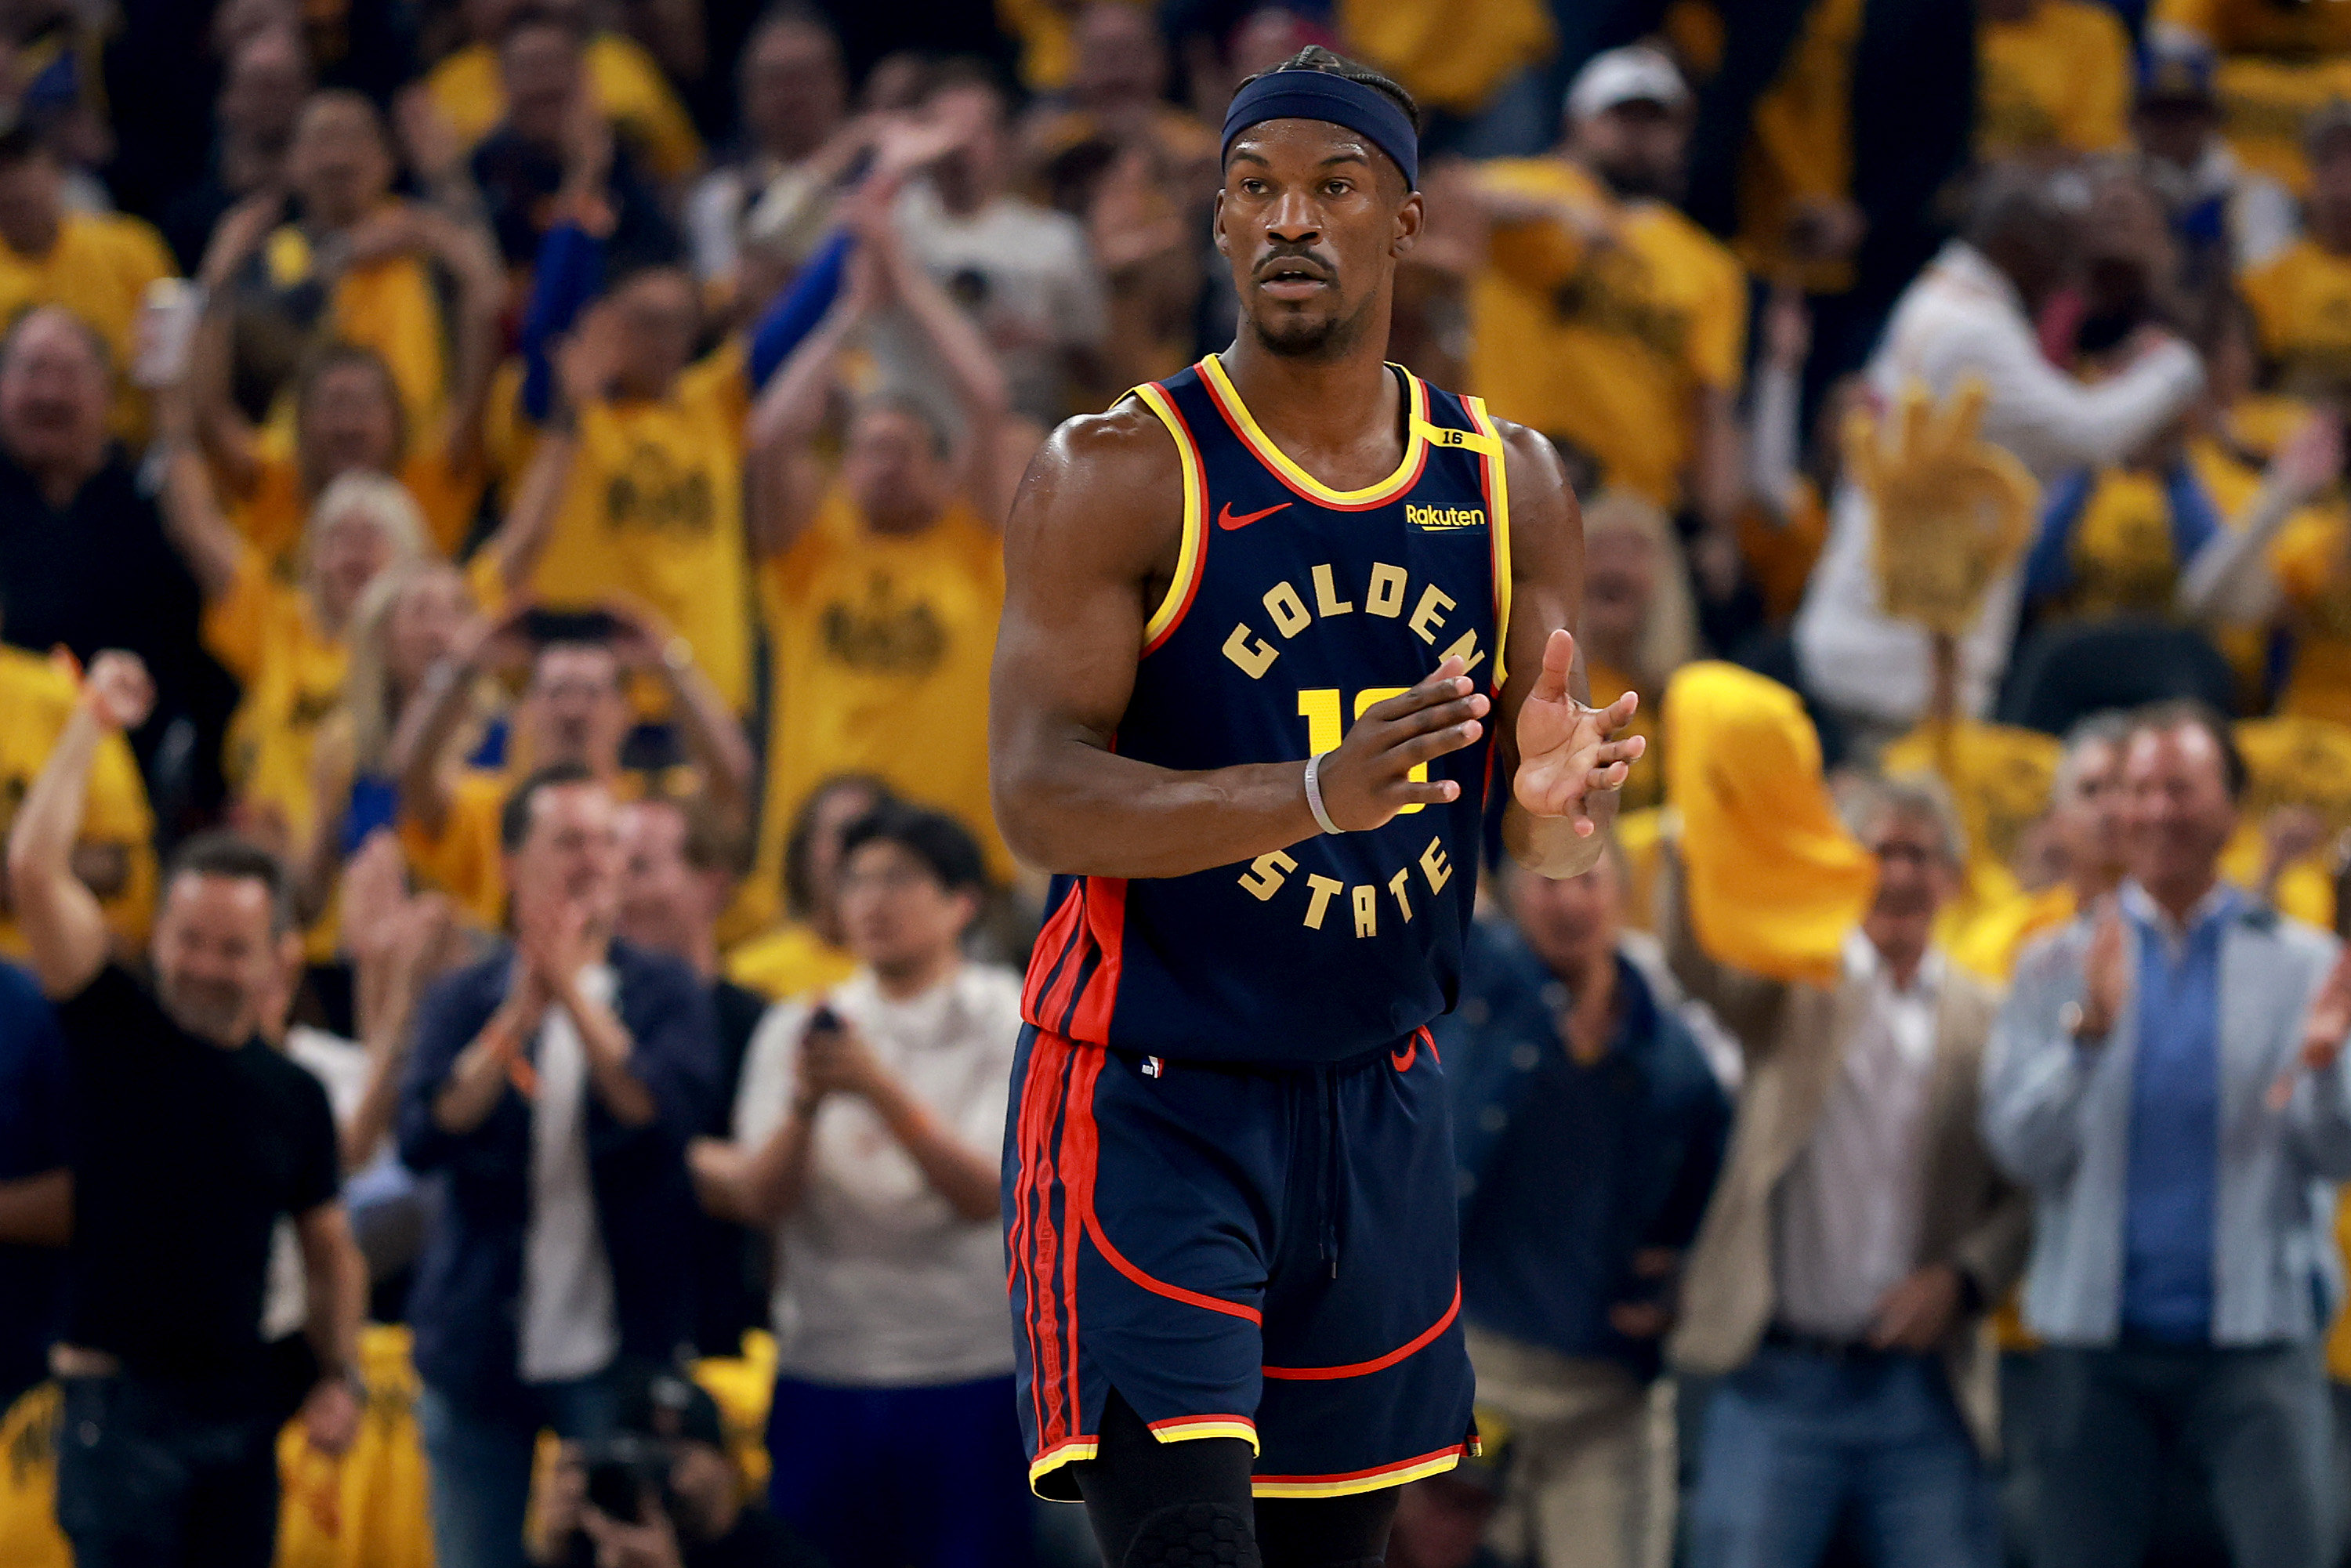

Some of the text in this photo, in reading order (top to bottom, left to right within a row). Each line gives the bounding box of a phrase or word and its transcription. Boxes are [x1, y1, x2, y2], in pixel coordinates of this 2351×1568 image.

[1443, 431, 1463, 445] 16
[1405, 504, 1485, 526] Rakuten
[1222, 562, 1486, 680] GOLDEN
[1237, 835, 1453, 938] STATE
